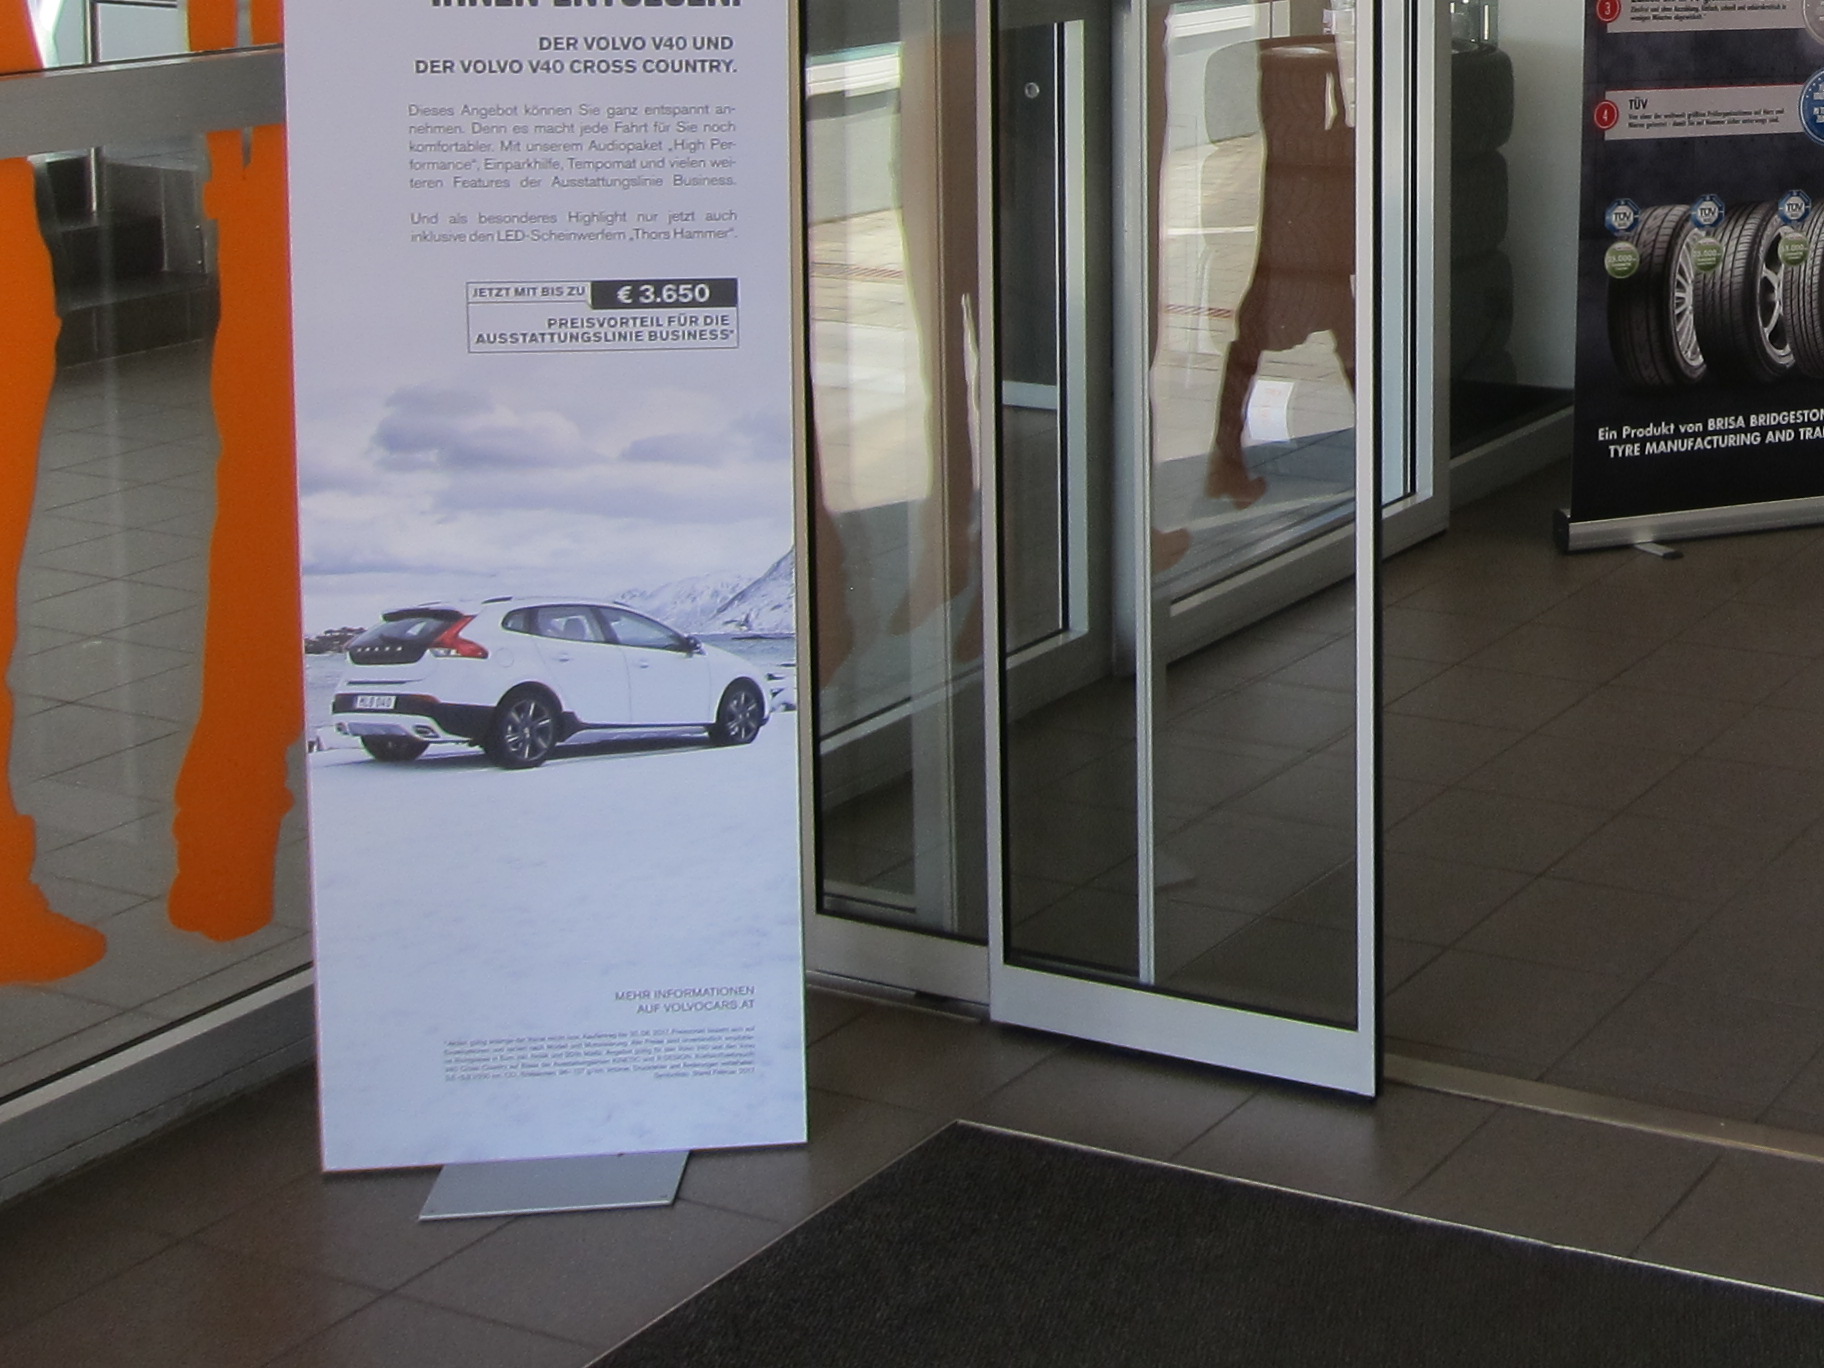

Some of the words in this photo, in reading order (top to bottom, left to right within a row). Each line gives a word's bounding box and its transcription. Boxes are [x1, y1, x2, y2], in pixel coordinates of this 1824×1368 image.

[539, 37, 578, 50] DER
[584, 37, 646, 50] VOLVO
[651, 36, 687, 50] V40
[693, 37, 733, 50] UND
[416, 60, 454, 73] DER
[460, 60, 523, 74] VOLVO
[528, 60, 564, 73] V40
[570, 60, 637, 73] CROSS
[1628, 96, 1648, 110] TÜV
[473, 287, 510, 297] JETZT
[514, 287, 538, 296] MIT
[541, 287, 564, 296] BIS
[567, 286, 585, 296] ZU
[617, 286, 632, 303] €
[640, 284, 709, 303] 3.650
[548, 317, 663, 329] PREISVORTEIL
[668, 313, 699, 326] FÜR
[704, 315, 729, 326] DIE
[476, 331, 644, 344] AUSSTATTUNGSLINIE
[1599, 427, 1617, 440] Ein
[1623, 422, 1674, 438] Produkt
[1679, 423, 1702, 433] von
[1708, 416, 1745, 430] BRISA
[1609, 443, 1640, 457] TYRE
[1645, 432, 1761, 454] MANUFACTURING
[1765, 429, 1794, 443] AND
[615, 990, 650, 1001] MEHR
[654, 986, 754, 998] INFORMATIONEN
[637, 1004, 660, 1014] AUF
